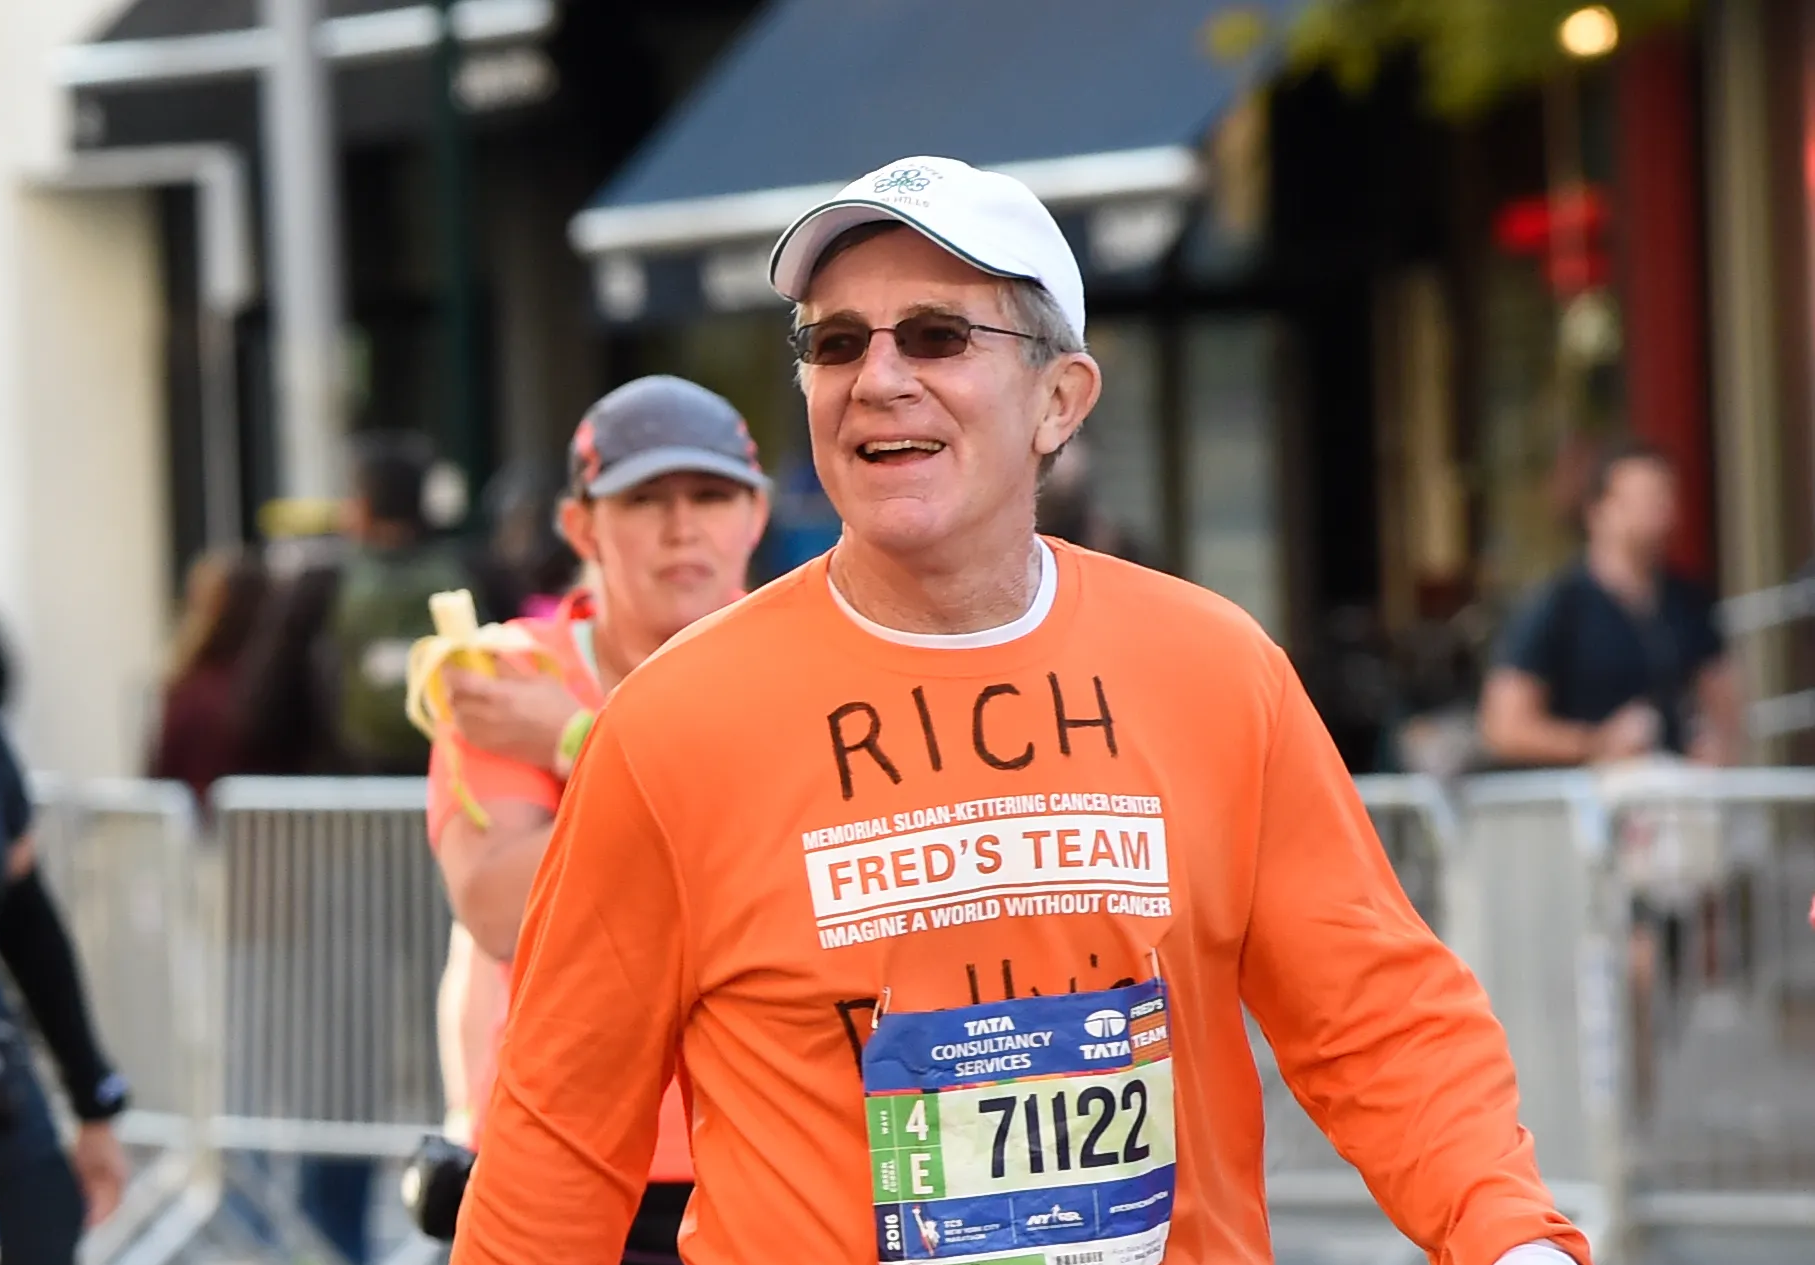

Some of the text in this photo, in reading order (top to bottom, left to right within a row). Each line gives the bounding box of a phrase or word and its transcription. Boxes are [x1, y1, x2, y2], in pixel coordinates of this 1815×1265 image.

[827, 671, 1119, 800] RICH
[802, 793, 1162, 851] MEMORIAL SLOAN-KETTERING CANCER CENTER
[827, 828, 1151, 902] FRED'S TEAM
[818, 894, 1172, 949] IMAGINE A WORLD WITHOUT CANCER
[931, 1031, 1054, 1061] CONSULTANCY
[964, 1016, 1015, 1037] TATA
[1131, 1025, 1167, 1049] TEAM
[954, 1054, 1032, 1077] SERVICES
[1079, 1040, 1131, 1060] TATA
[905, 1099, 929, 1141] 4
[979, 1079, 1151, 1179] 71122
[909, 1153, 934, 1195] E
[884, 1214, 901, 1251] 2016
